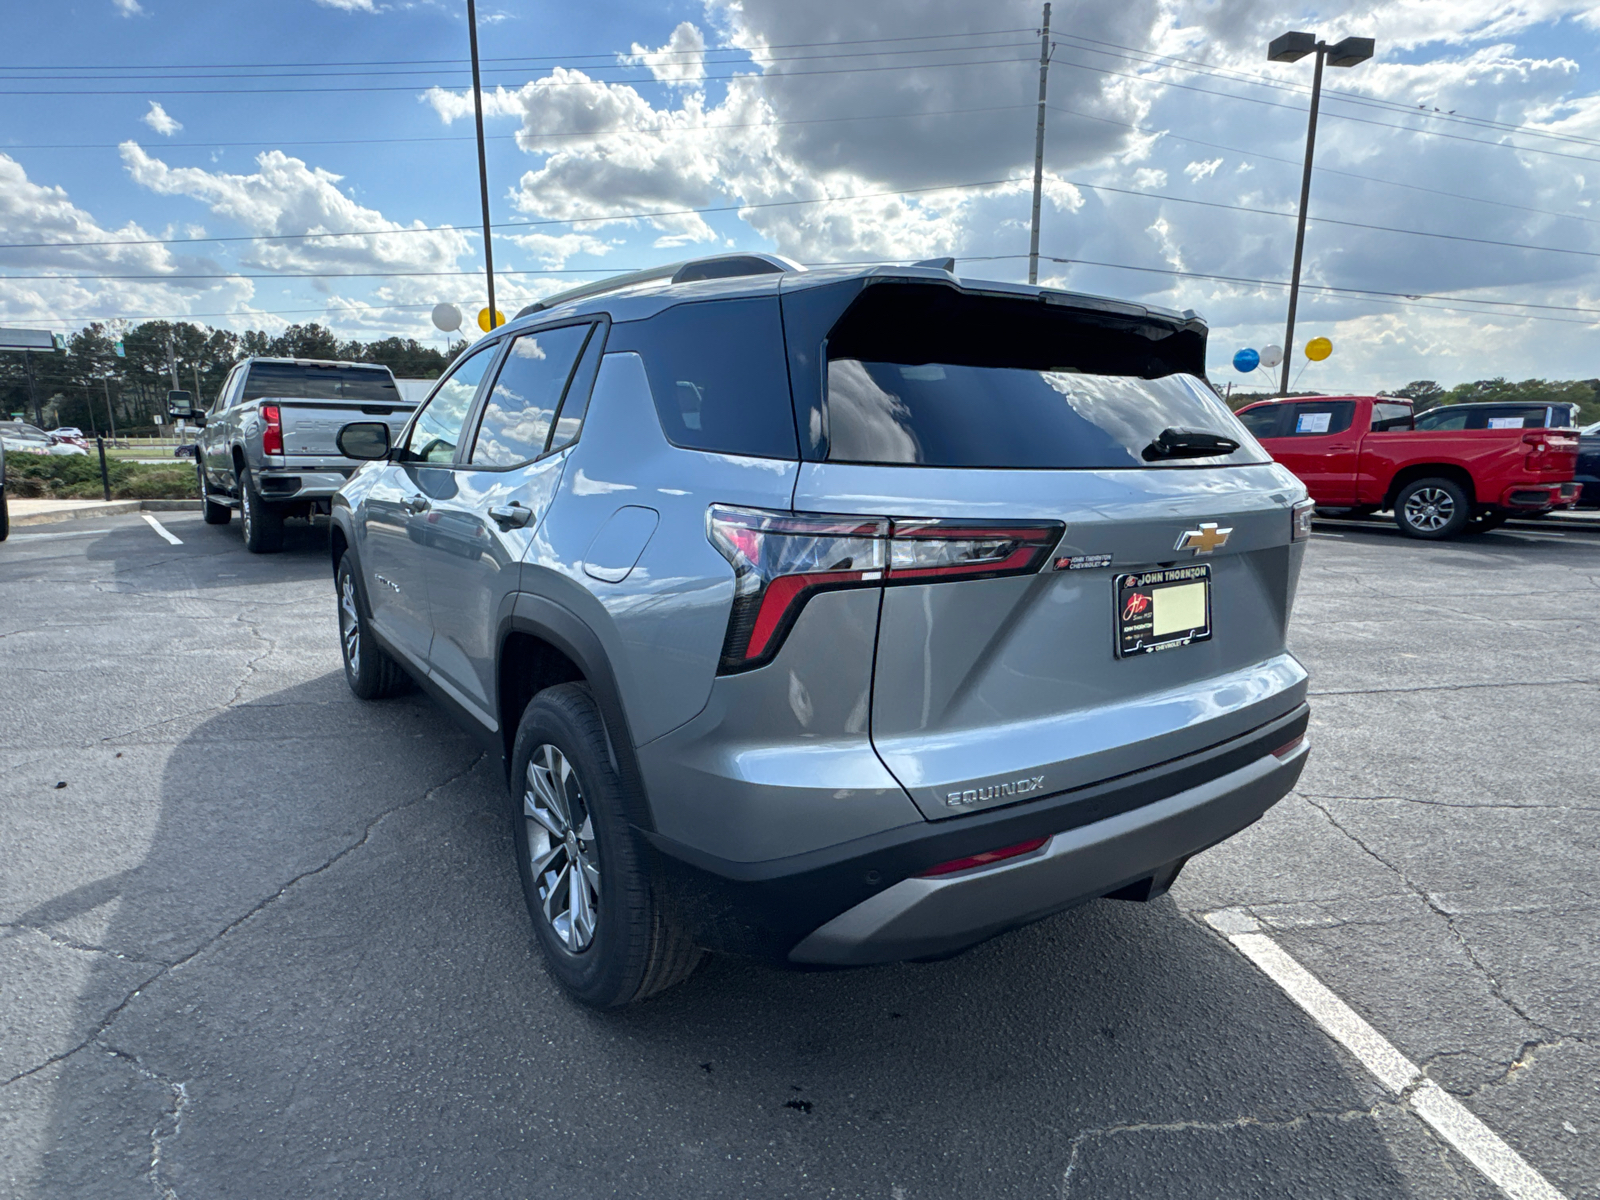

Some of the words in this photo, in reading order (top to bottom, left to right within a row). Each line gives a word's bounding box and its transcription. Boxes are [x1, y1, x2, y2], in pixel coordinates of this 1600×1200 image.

[1085, 554, 1112, 562] THORNTON
[1069, 561, 1101, 569] CHEVROLET
[1137, 572, 1163, 587] JOHN
[1165, 567, 1207, 582] THORNTON
[1134, 622, 1153, 630] THORNTON
[1155, 641, 1182, 652] CHEVROLET
[946, 775, 1045, 806] EQUINOX
